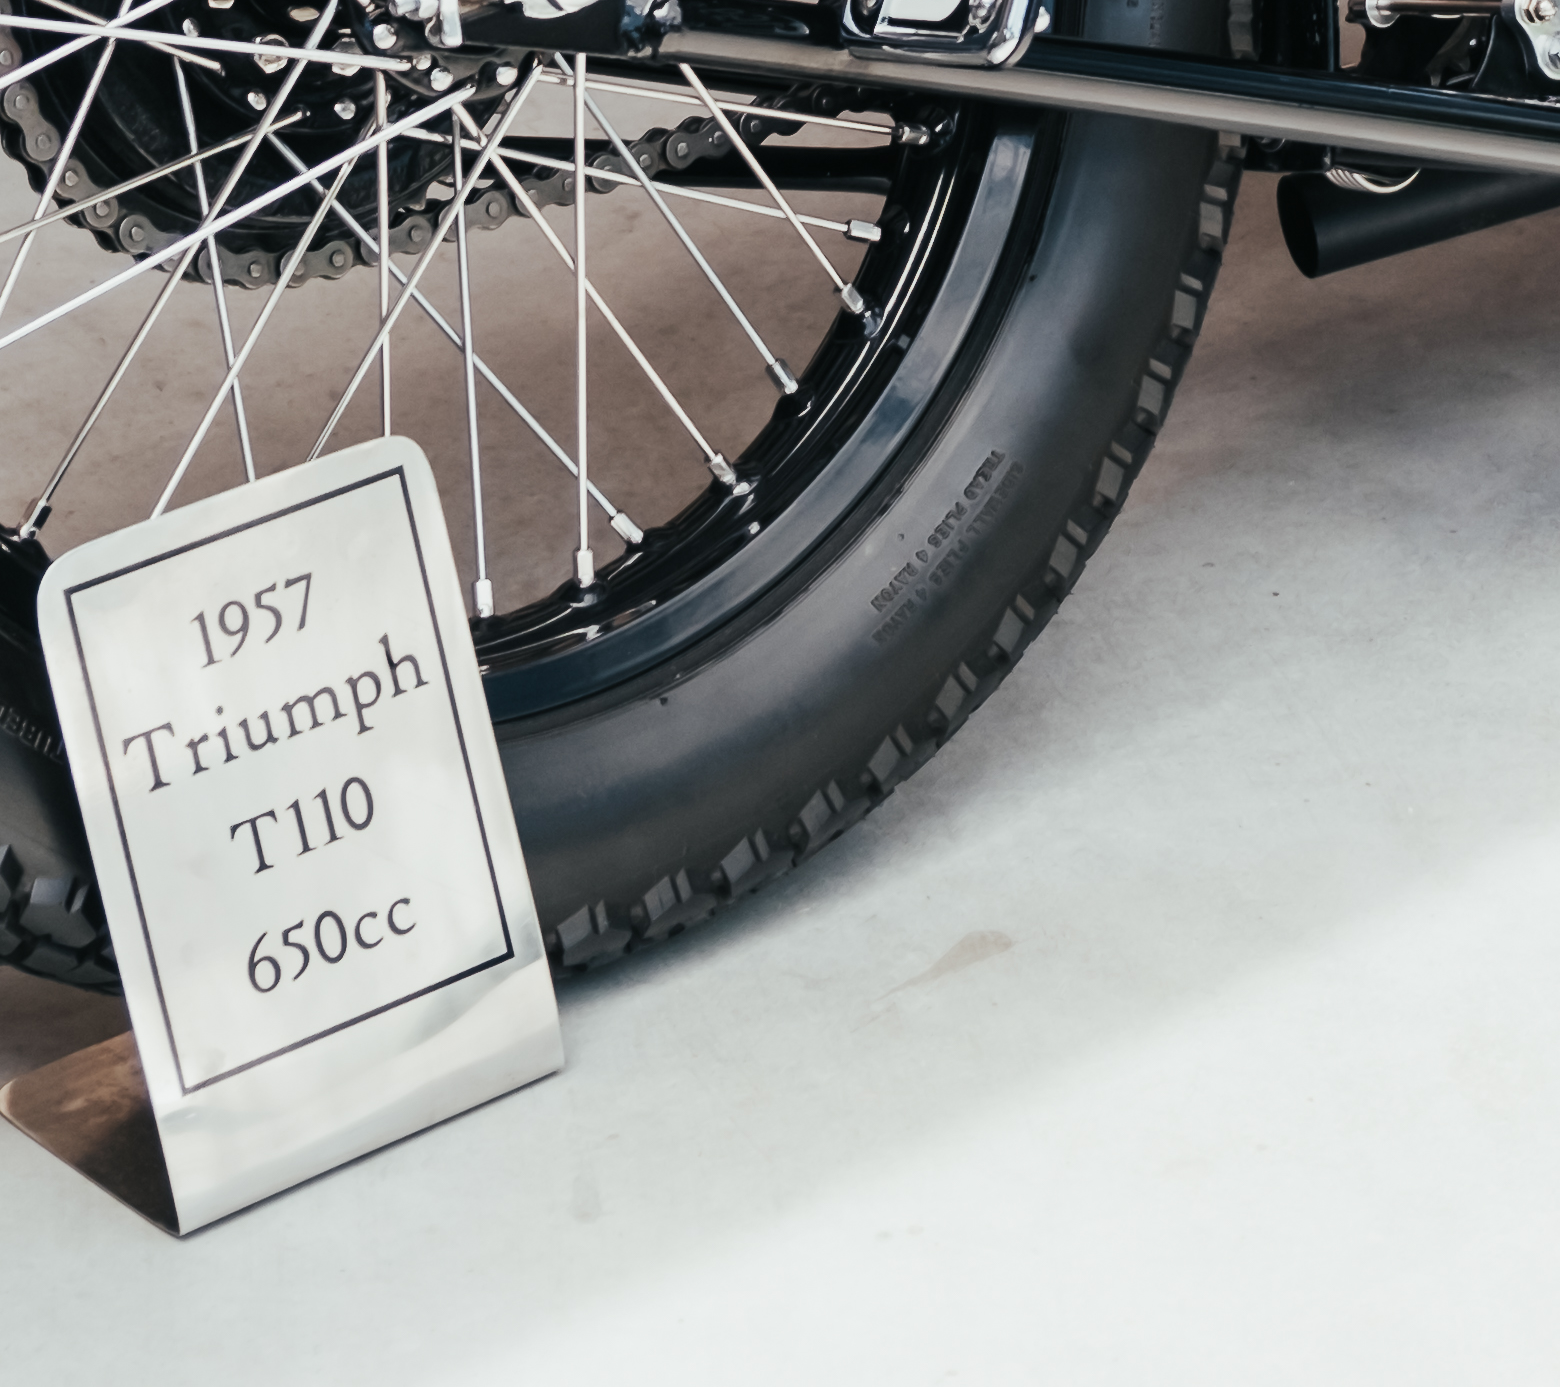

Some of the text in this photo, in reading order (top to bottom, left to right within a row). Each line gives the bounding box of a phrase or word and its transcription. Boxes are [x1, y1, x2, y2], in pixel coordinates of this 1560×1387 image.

[964, 449, 1005, 501] TREAD
[927, 501, 966, 550] PLIES
[190, 571, 315, 670] 1957
[870, 561, 919, 613] RAYON
[122, 633, 429, 793] Triumph
[230, 776, 375, 875] T110
[247, 897, 417, 993] 650cc
